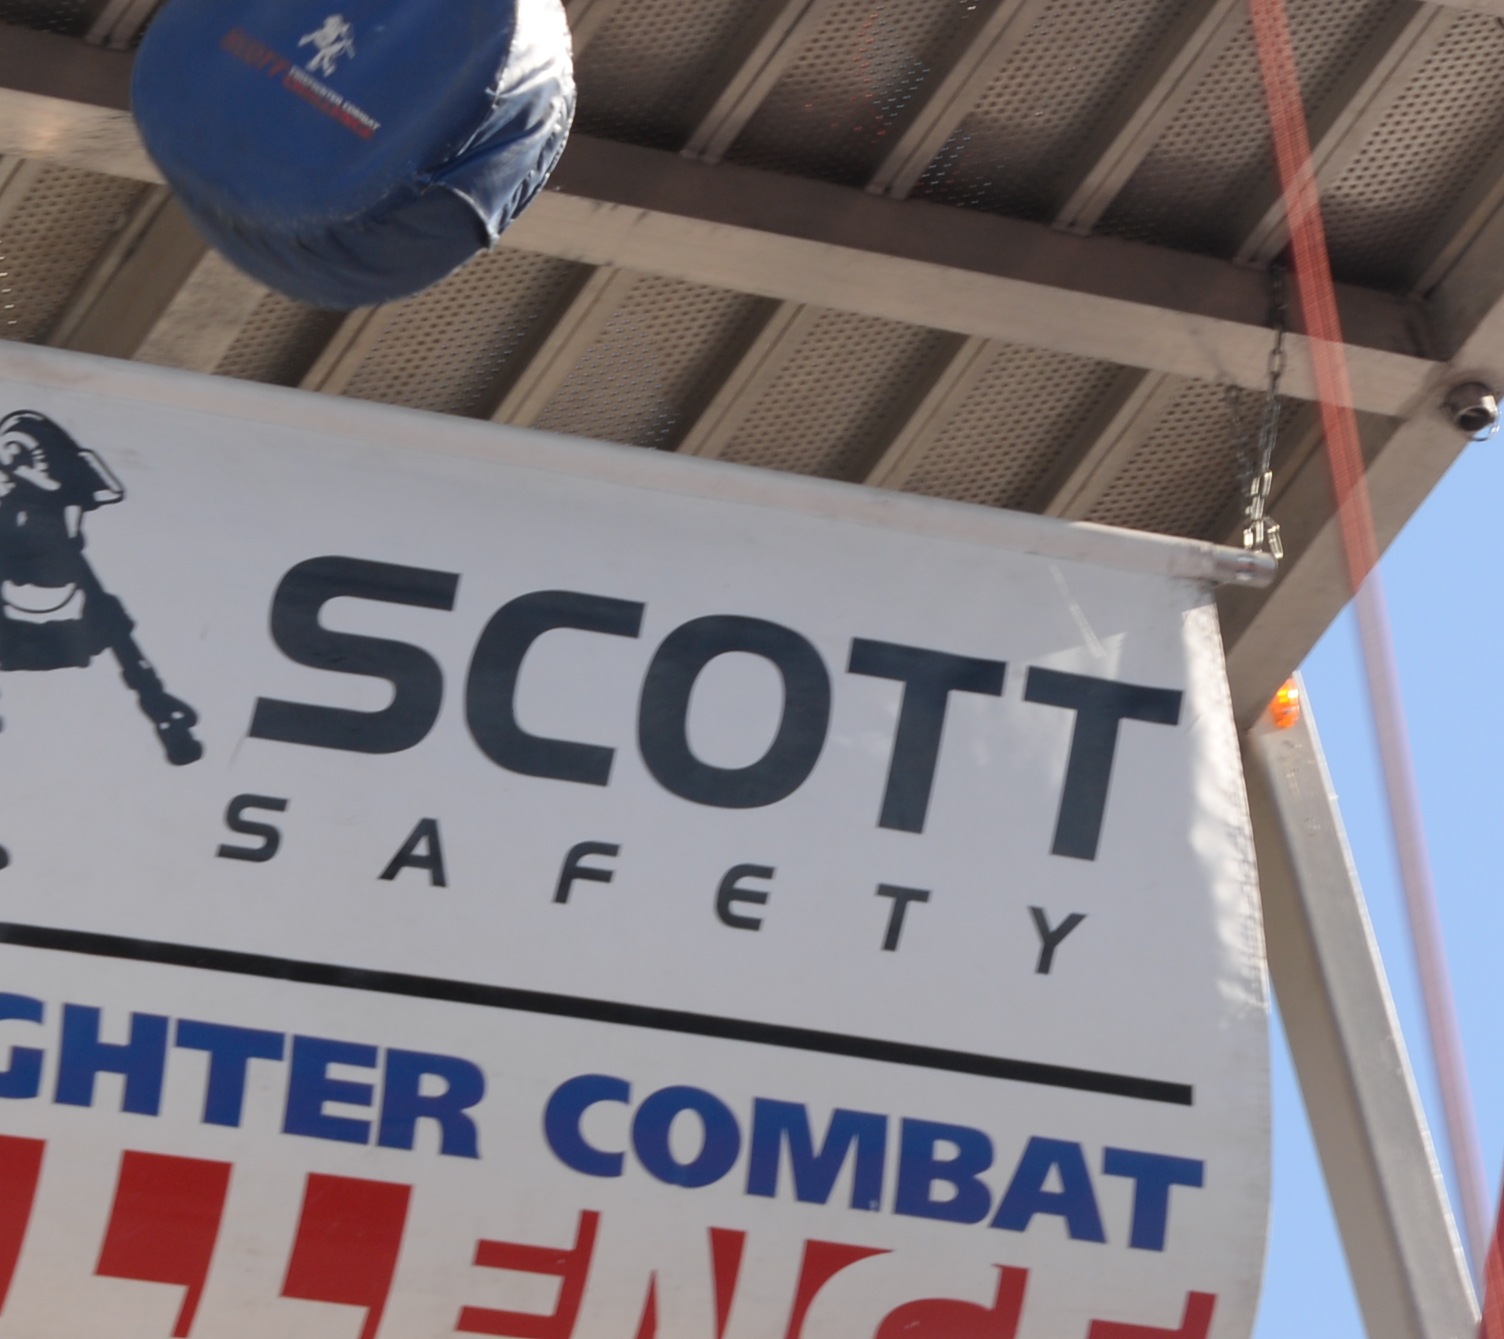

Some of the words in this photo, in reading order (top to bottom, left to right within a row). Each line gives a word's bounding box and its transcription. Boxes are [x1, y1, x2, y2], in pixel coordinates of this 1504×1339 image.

[248, 554, 1183, 861] SCOTT
[215, 792, 1087, 975] SAFETY
[542, 1073, 1205, 1252] COMBAT
